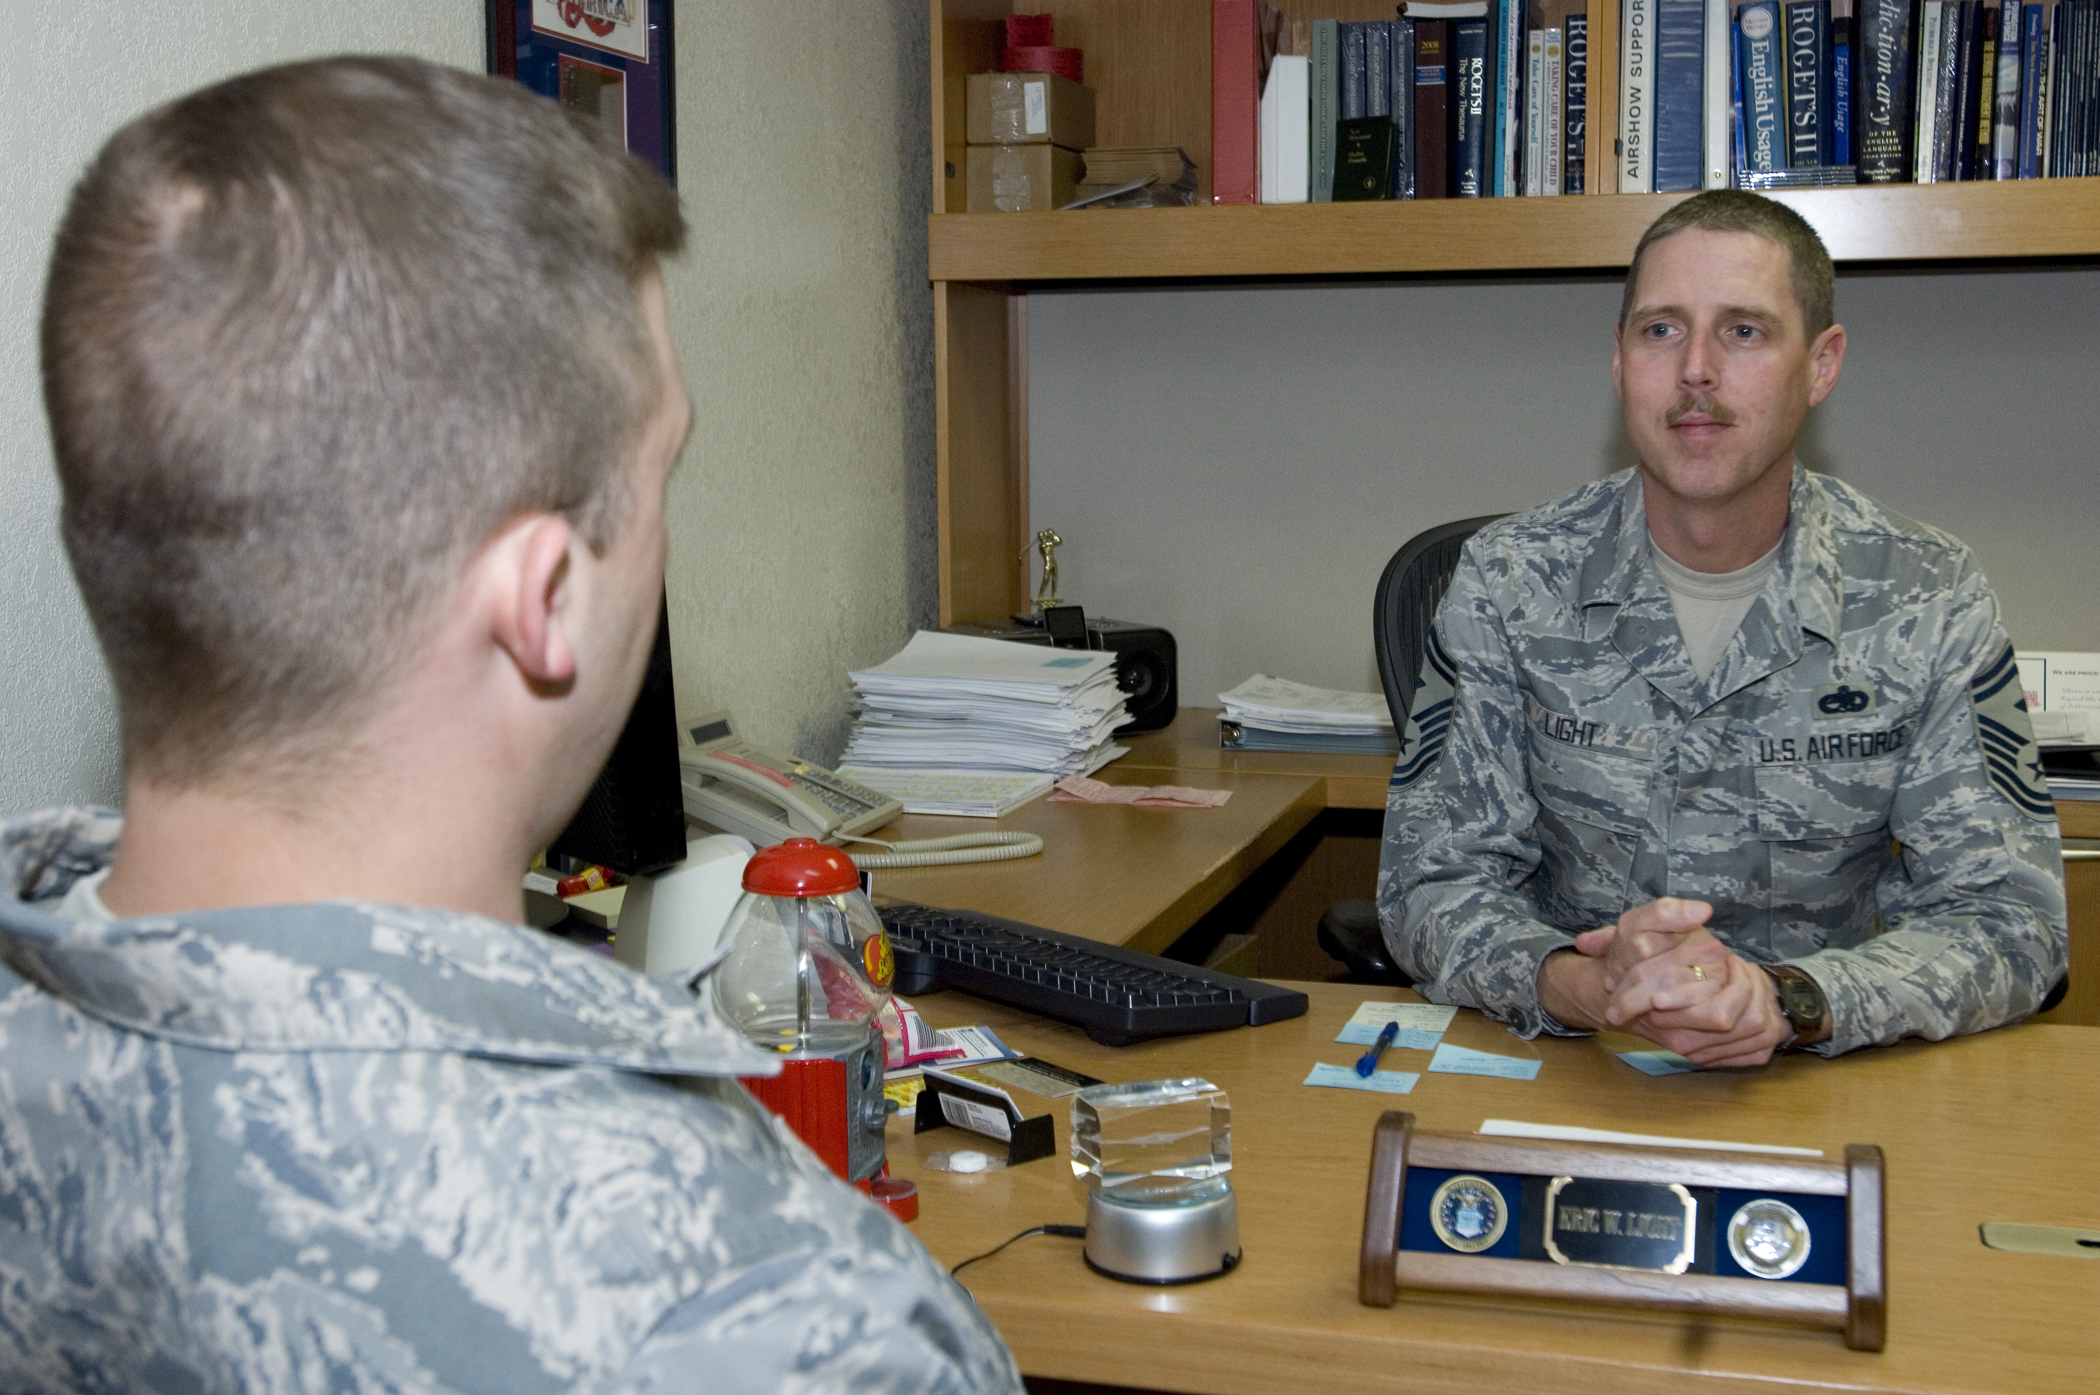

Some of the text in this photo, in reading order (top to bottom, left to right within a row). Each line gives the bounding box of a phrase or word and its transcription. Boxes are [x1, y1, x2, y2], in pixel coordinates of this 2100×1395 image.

[1532, 58, 1540, 78] Take
[1552, 60, 1560, 92] TAKING
[1834, 56, 1848, 98] English
[2040, 56, 2048, 74] TZU
[1470, 58, 1482, 106] ROGET'S
[1532, 80, 1540, 100] Care
[1628, 0, 1644, 178] AIRSHOW SUPPOR
[1792, 5, 1817, 155] ROGET'S II
[1459, 58, 1468, 141] The New Thesaurus
[1532, 102, 1540, 110] of
[1748, 39, 1774, 170] English Usage
[1550, 119, 1558, 131] OF
[1834, 102, 1848, 132] Usage
[2037, 116, 2044, 131] OF
[1550, 133, 1558, 156] YOUR
[1550, 158, 1558, 186] CHILD
[1545, 712, 1600, 747] LIGHT
[1760, 738, 1802, 762] U.S.
[1807, 735, 1844, 760] AIR
